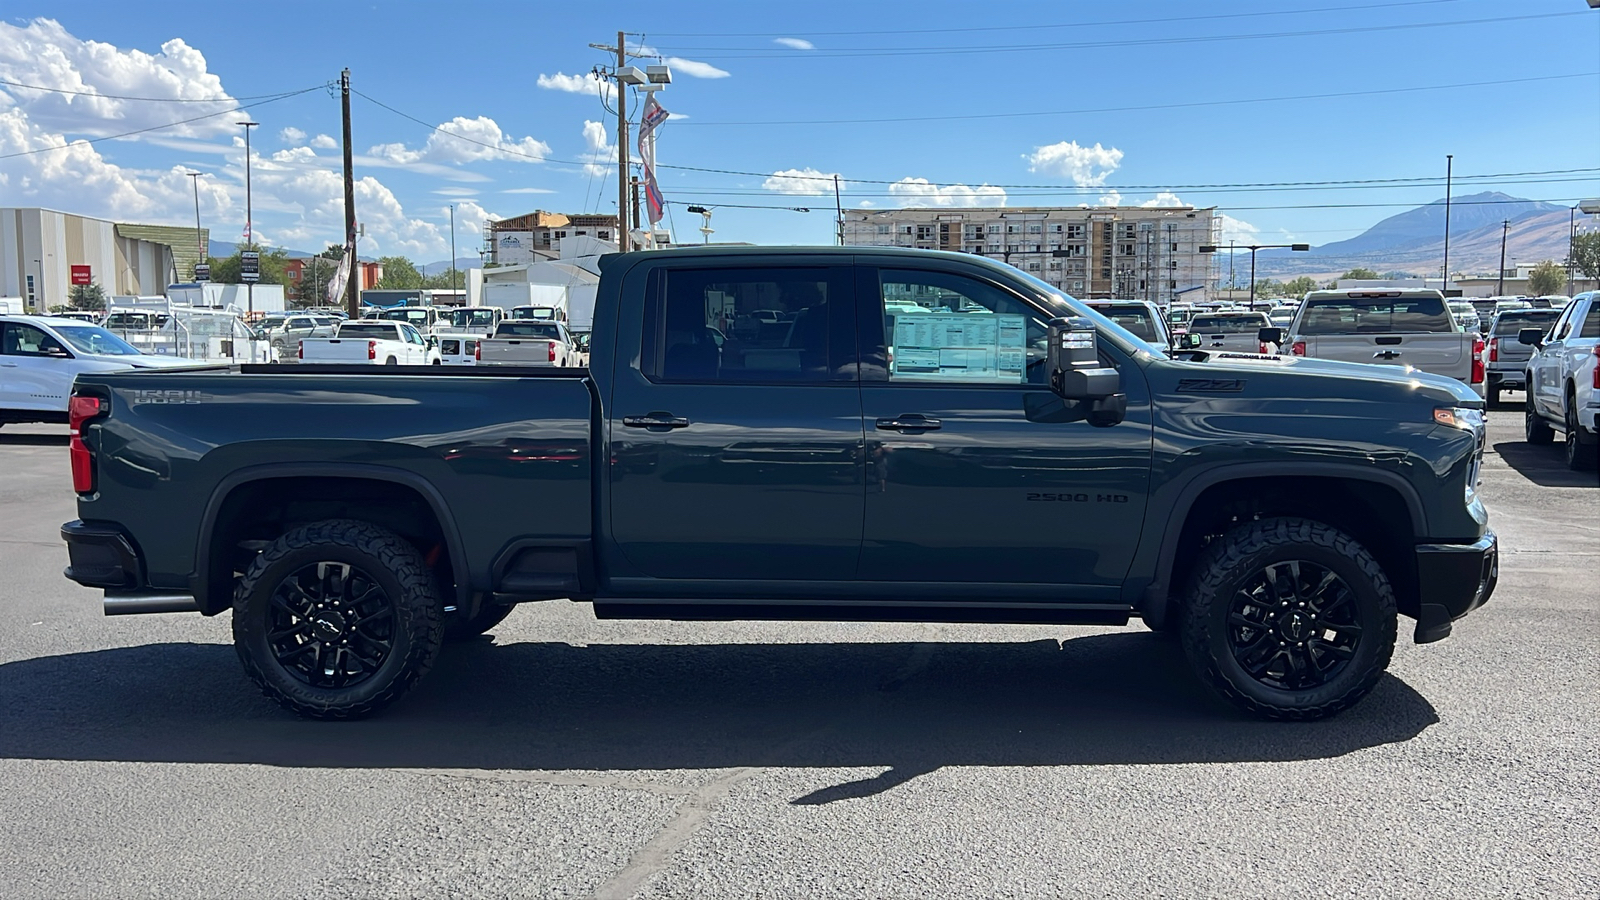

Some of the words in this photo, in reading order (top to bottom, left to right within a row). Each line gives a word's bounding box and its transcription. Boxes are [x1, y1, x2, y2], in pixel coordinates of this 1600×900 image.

[123, 389, 213, 399] TRAIL
[134, 397, 201, 405] BOSS
[1026, 492, 1089, 503] 2500
[1096, 494, 1129, 503] HD
